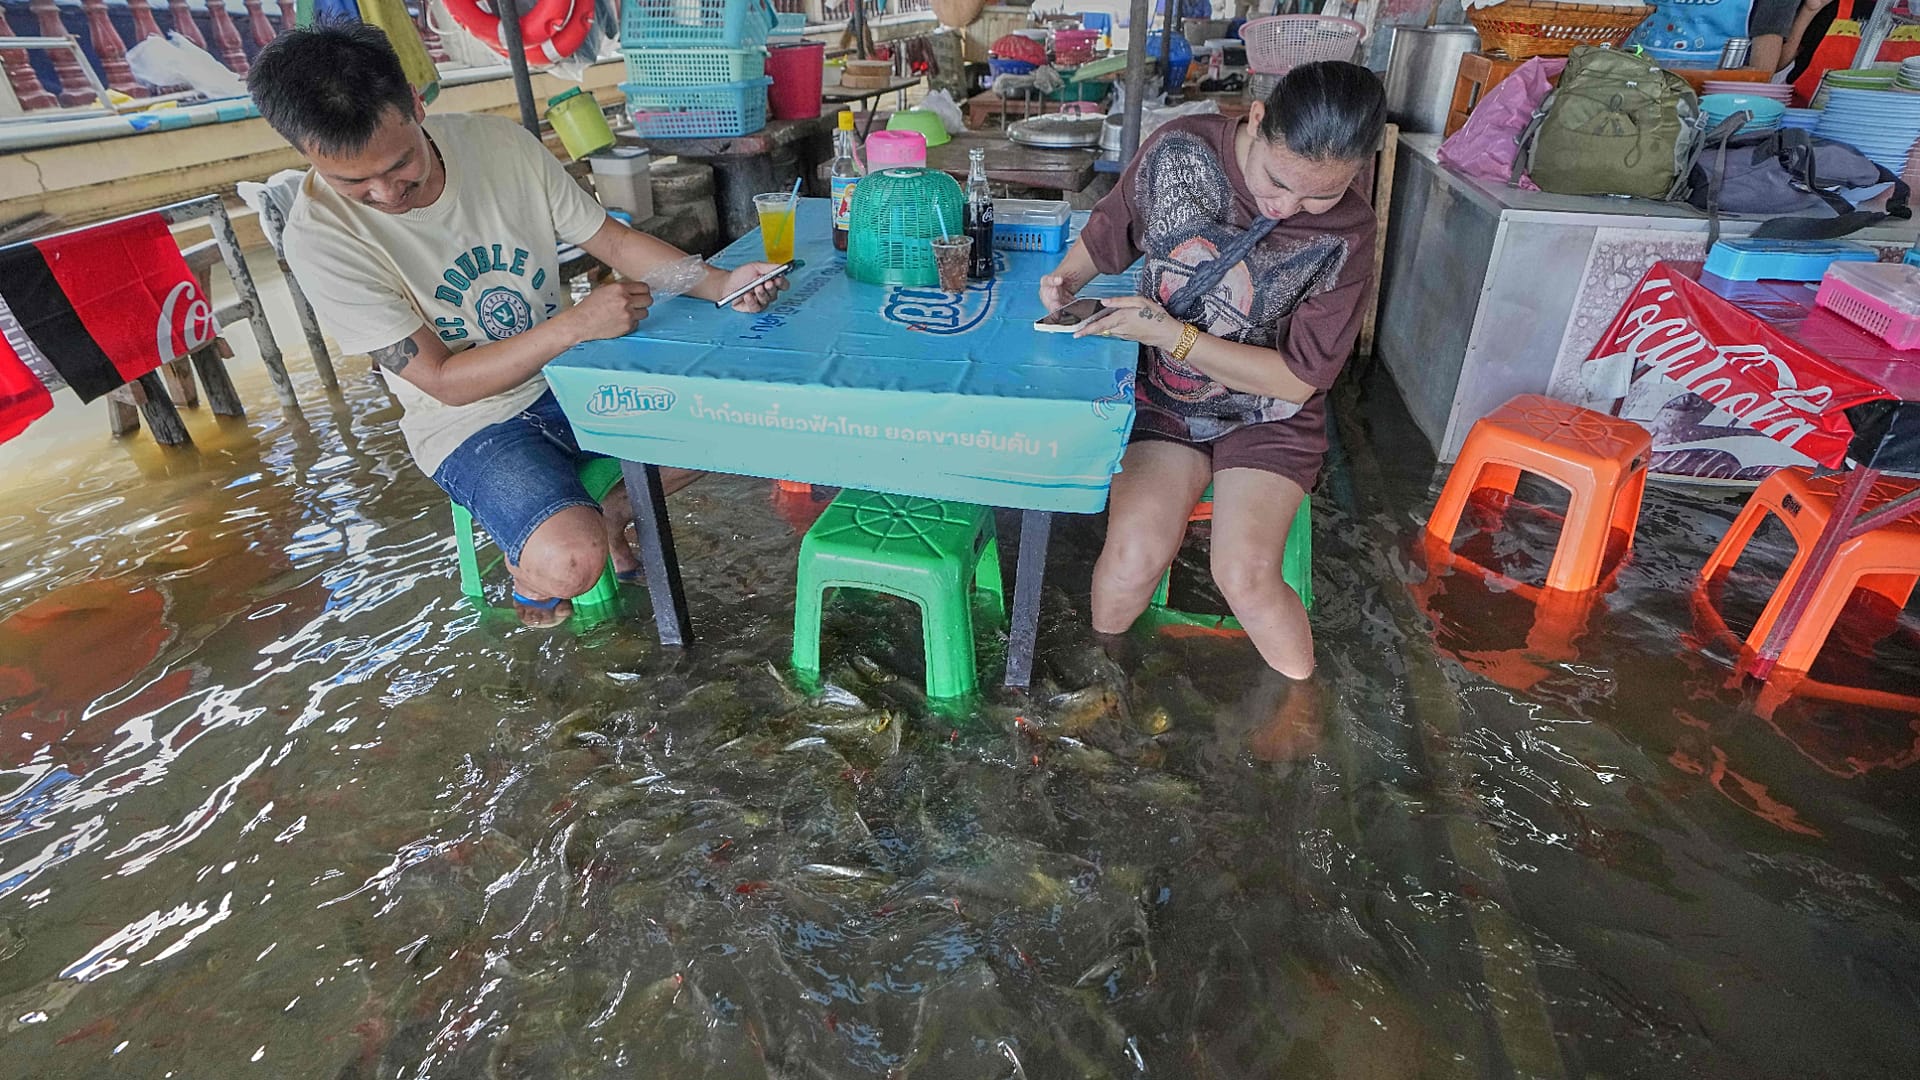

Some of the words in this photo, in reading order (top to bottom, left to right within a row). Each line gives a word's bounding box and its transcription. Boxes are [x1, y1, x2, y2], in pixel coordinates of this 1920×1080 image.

[435, 244, 529, 308] DOUBLE
[435, 317, 469, 341] CC
[592, 384, 673, 413] ฟ้าไทย
[689, 394, 878, 438] น้ำก๋วยเตี๋ยวฟ้าไทย
[884, 424, 1040, 457] ยอดขายอันดับ
[1048, 440, 1059, 458] 1
